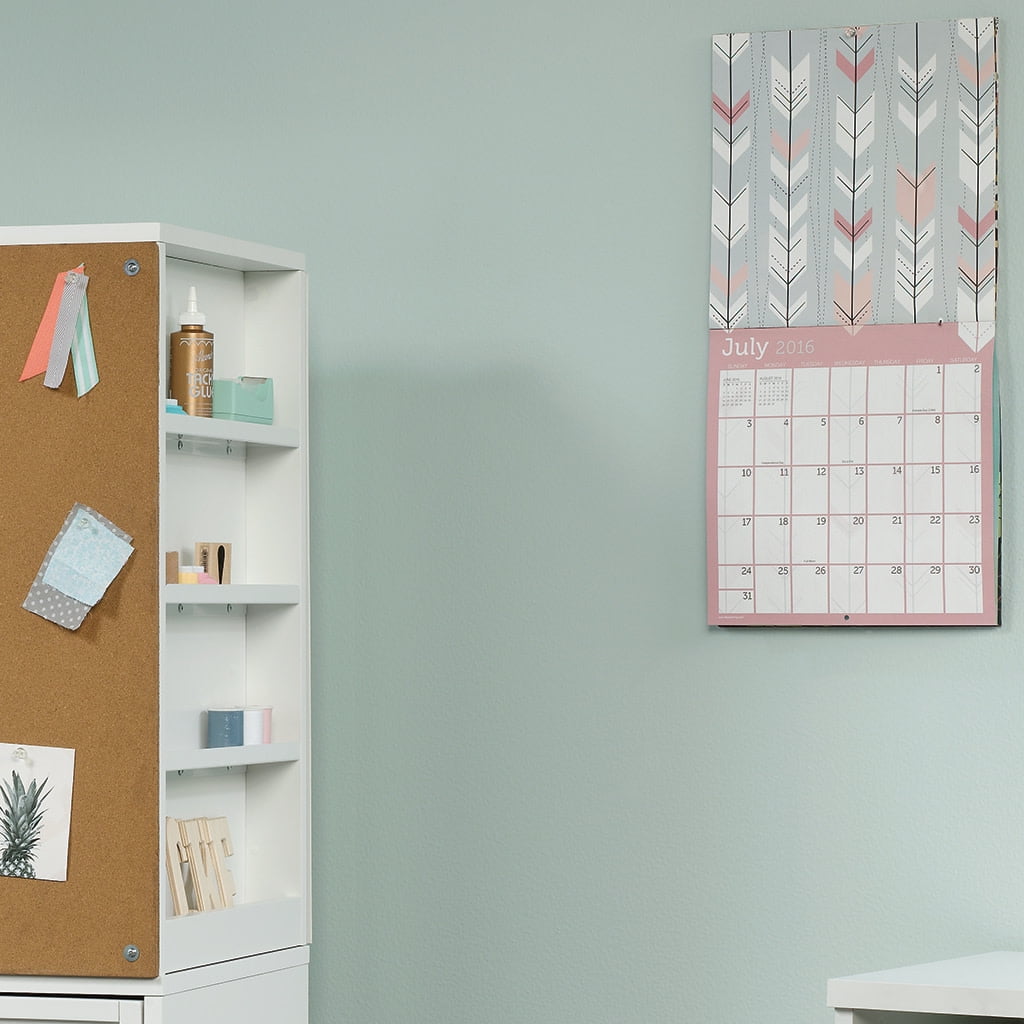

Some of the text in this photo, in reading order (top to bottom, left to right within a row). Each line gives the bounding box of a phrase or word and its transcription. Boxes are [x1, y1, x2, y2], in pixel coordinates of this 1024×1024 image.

[722, 337, 815, 360] July 2016
[742, 464, 979, 477] 10 11 12 13 14 15 16
[742, 515, 980, 526] 17 18 19 20 21 22 23
[741, 565, 980, 575] 24 25 26 27 28 29 30
[742, 591, 752, 600] 31
